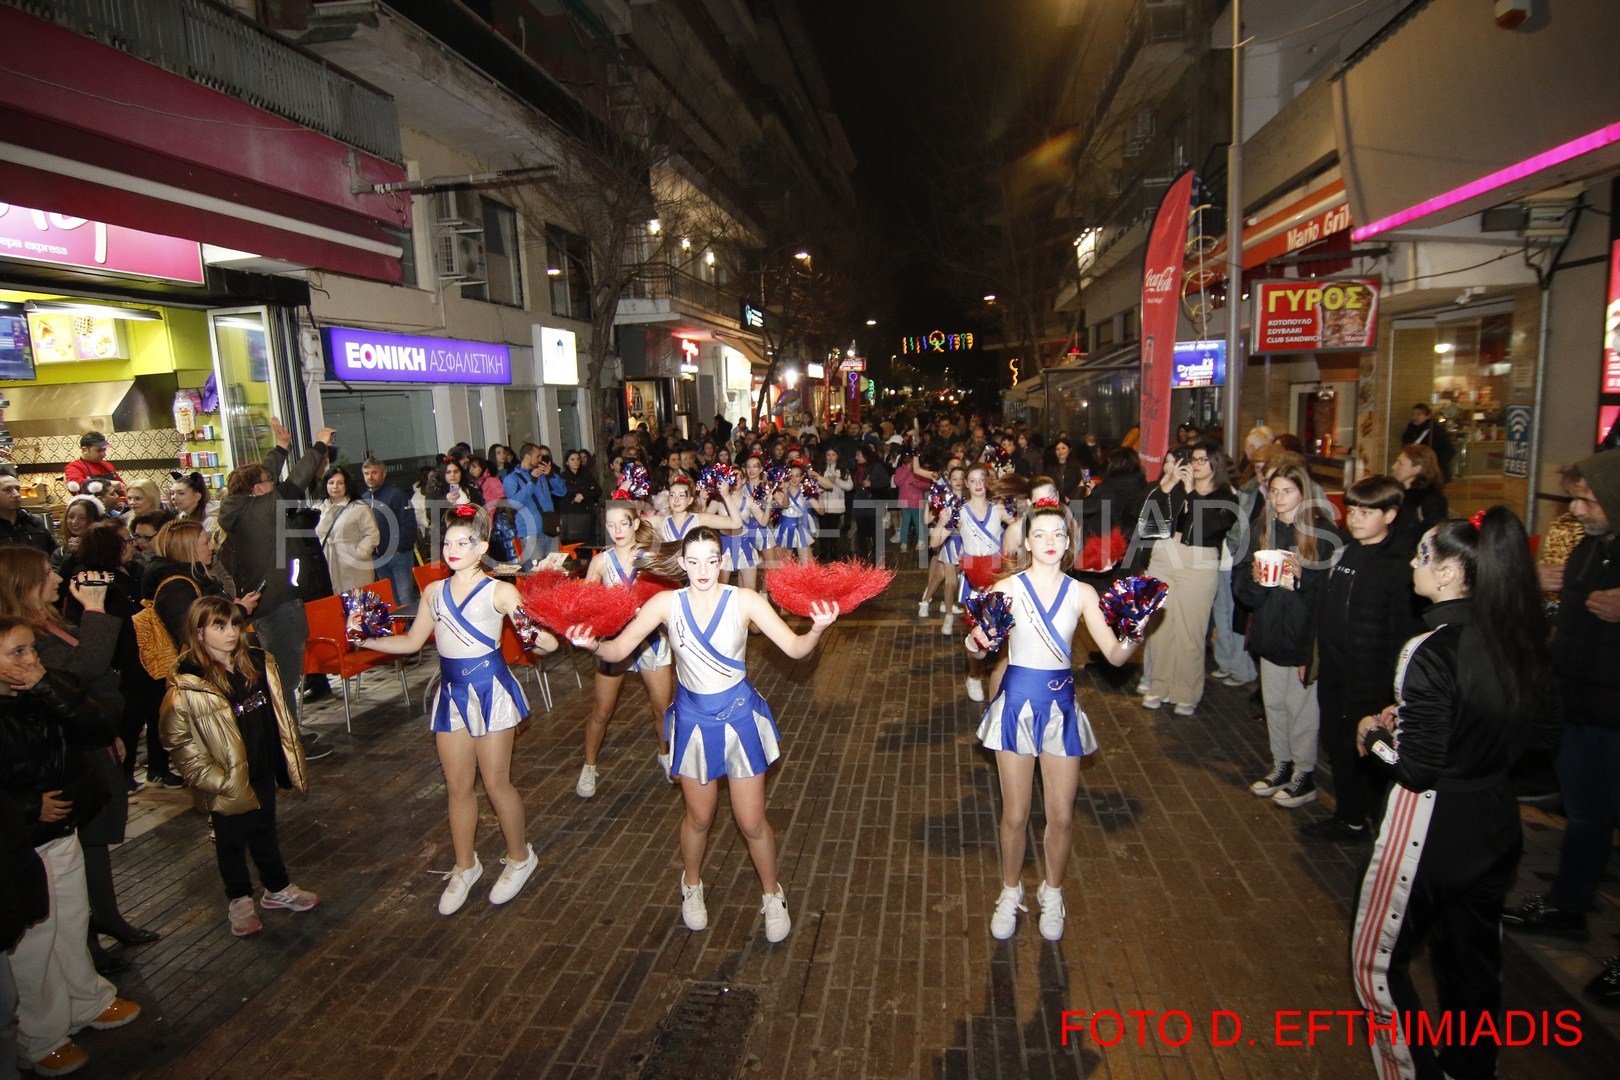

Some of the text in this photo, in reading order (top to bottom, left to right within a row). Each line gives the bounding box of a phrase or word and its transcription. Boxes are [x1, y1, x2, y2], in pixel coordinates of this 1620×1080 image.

[1287, 203, 1352, 252] Mario Gril
[24, 241, 68, 255] express
[1268, 286, 1363, 313] ΓΥΡΟΣ
[1268, 318, 1312, 326] ΚΟΤΟΠΟΥΛΟ
[1285, 335, 1323, 343] SANDWICH
[429, 349, 504, 375] ΑΣΦΑΛΙΣΤΙΚΗ
[1504, 459, 1529, 474] FREE
